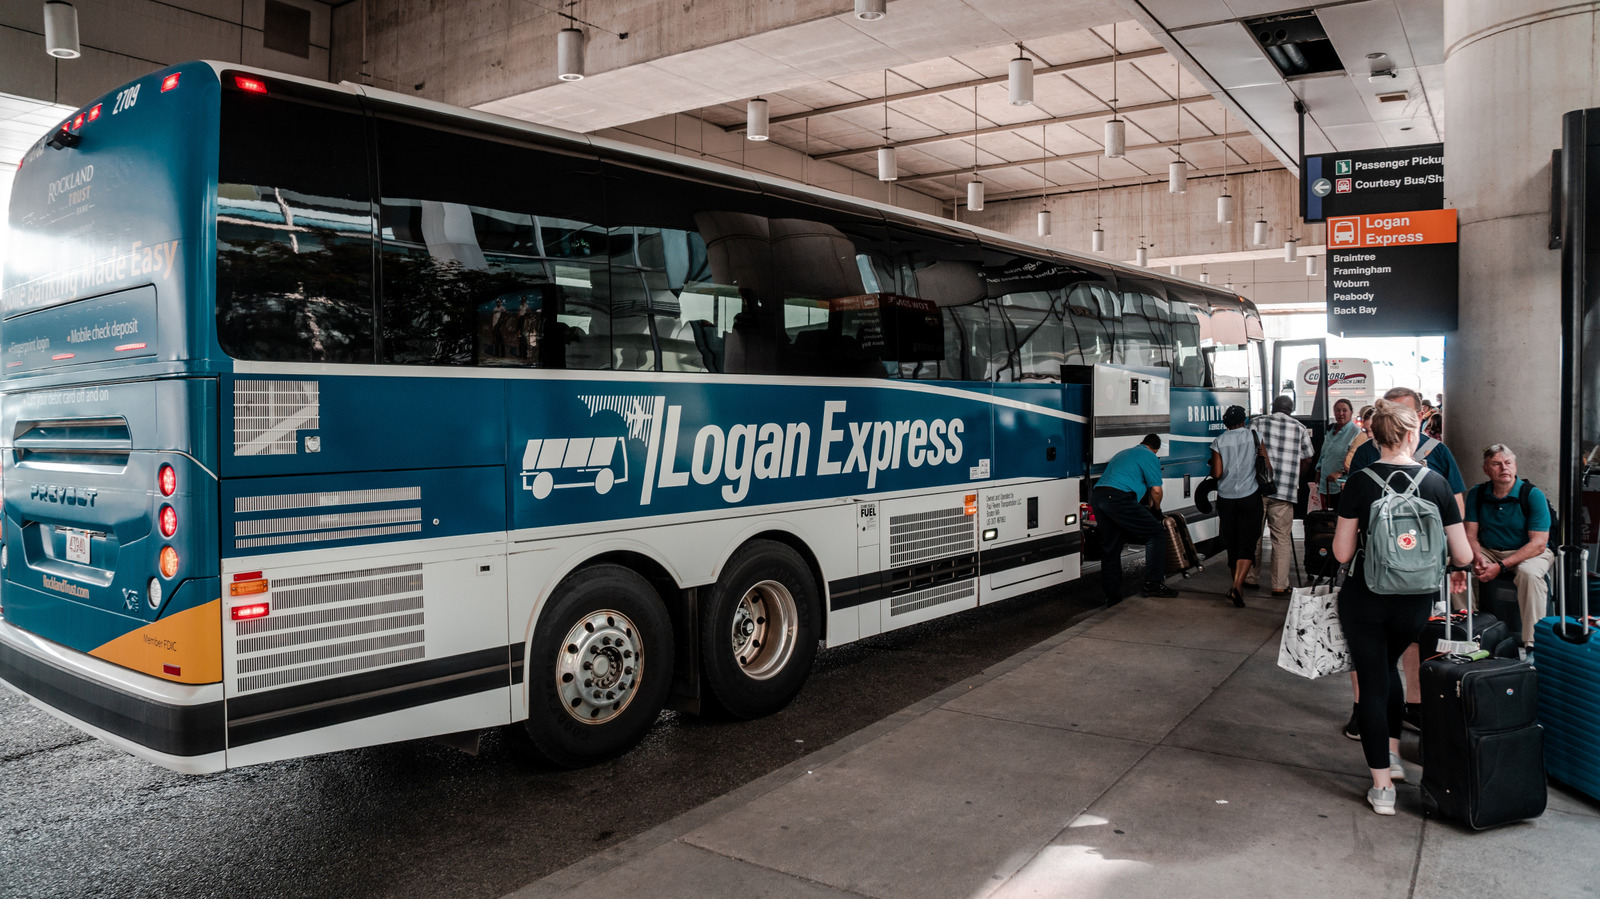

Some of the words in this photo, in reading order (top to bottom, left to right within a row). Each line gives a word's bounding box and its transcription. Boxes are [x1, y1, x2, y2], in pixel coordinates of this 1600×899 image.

[112, 83, 141, 115] 2709
[1355, 159, 1410, 171] Passenger
[48, 165, 94, 204] ROCKLAND
[1355, 178, 1401, 189] Courtesy
[68, 186, 91, 206] TRUST
[1366, 216, 1410, 229] Logan
[1366, 232, 1424, 246] Express
[81, 246, 127, 289] Made
[131, 240, 178, 280] Easy
[1333, 253, 1376, 263] Braintree
[1333, 265, 1391, 276] Framingham
[1333, 280, 1369, 289] Woburn
[1333, 292, 1374, 302] Peabody
[1333, 306, 1357, 315] Back
[1359, 305, 1377, 316] Bay
[71, 326, 91, 344] Mobile
[92, 322, 110, 340] check
[111, 318, 138, 339] deposit
[37, 336, 50, 353] login
[1309, 372, 1346, 381] COORD
[64, 390, 76, 404] card
[76, 387, 85, 403] off
[86, 387, 99, 402] and
[100, 389, 109, 402] on
[657, 405, 811, 504] Logan
[816, 400, 965, 489] Express
[860, 507, 877, 518] FUEL
[42, 574, 90, 600] RocklandTrust.com
[144, 634, 163, 648] Member
[163, 639, 177, 652] FDIC
